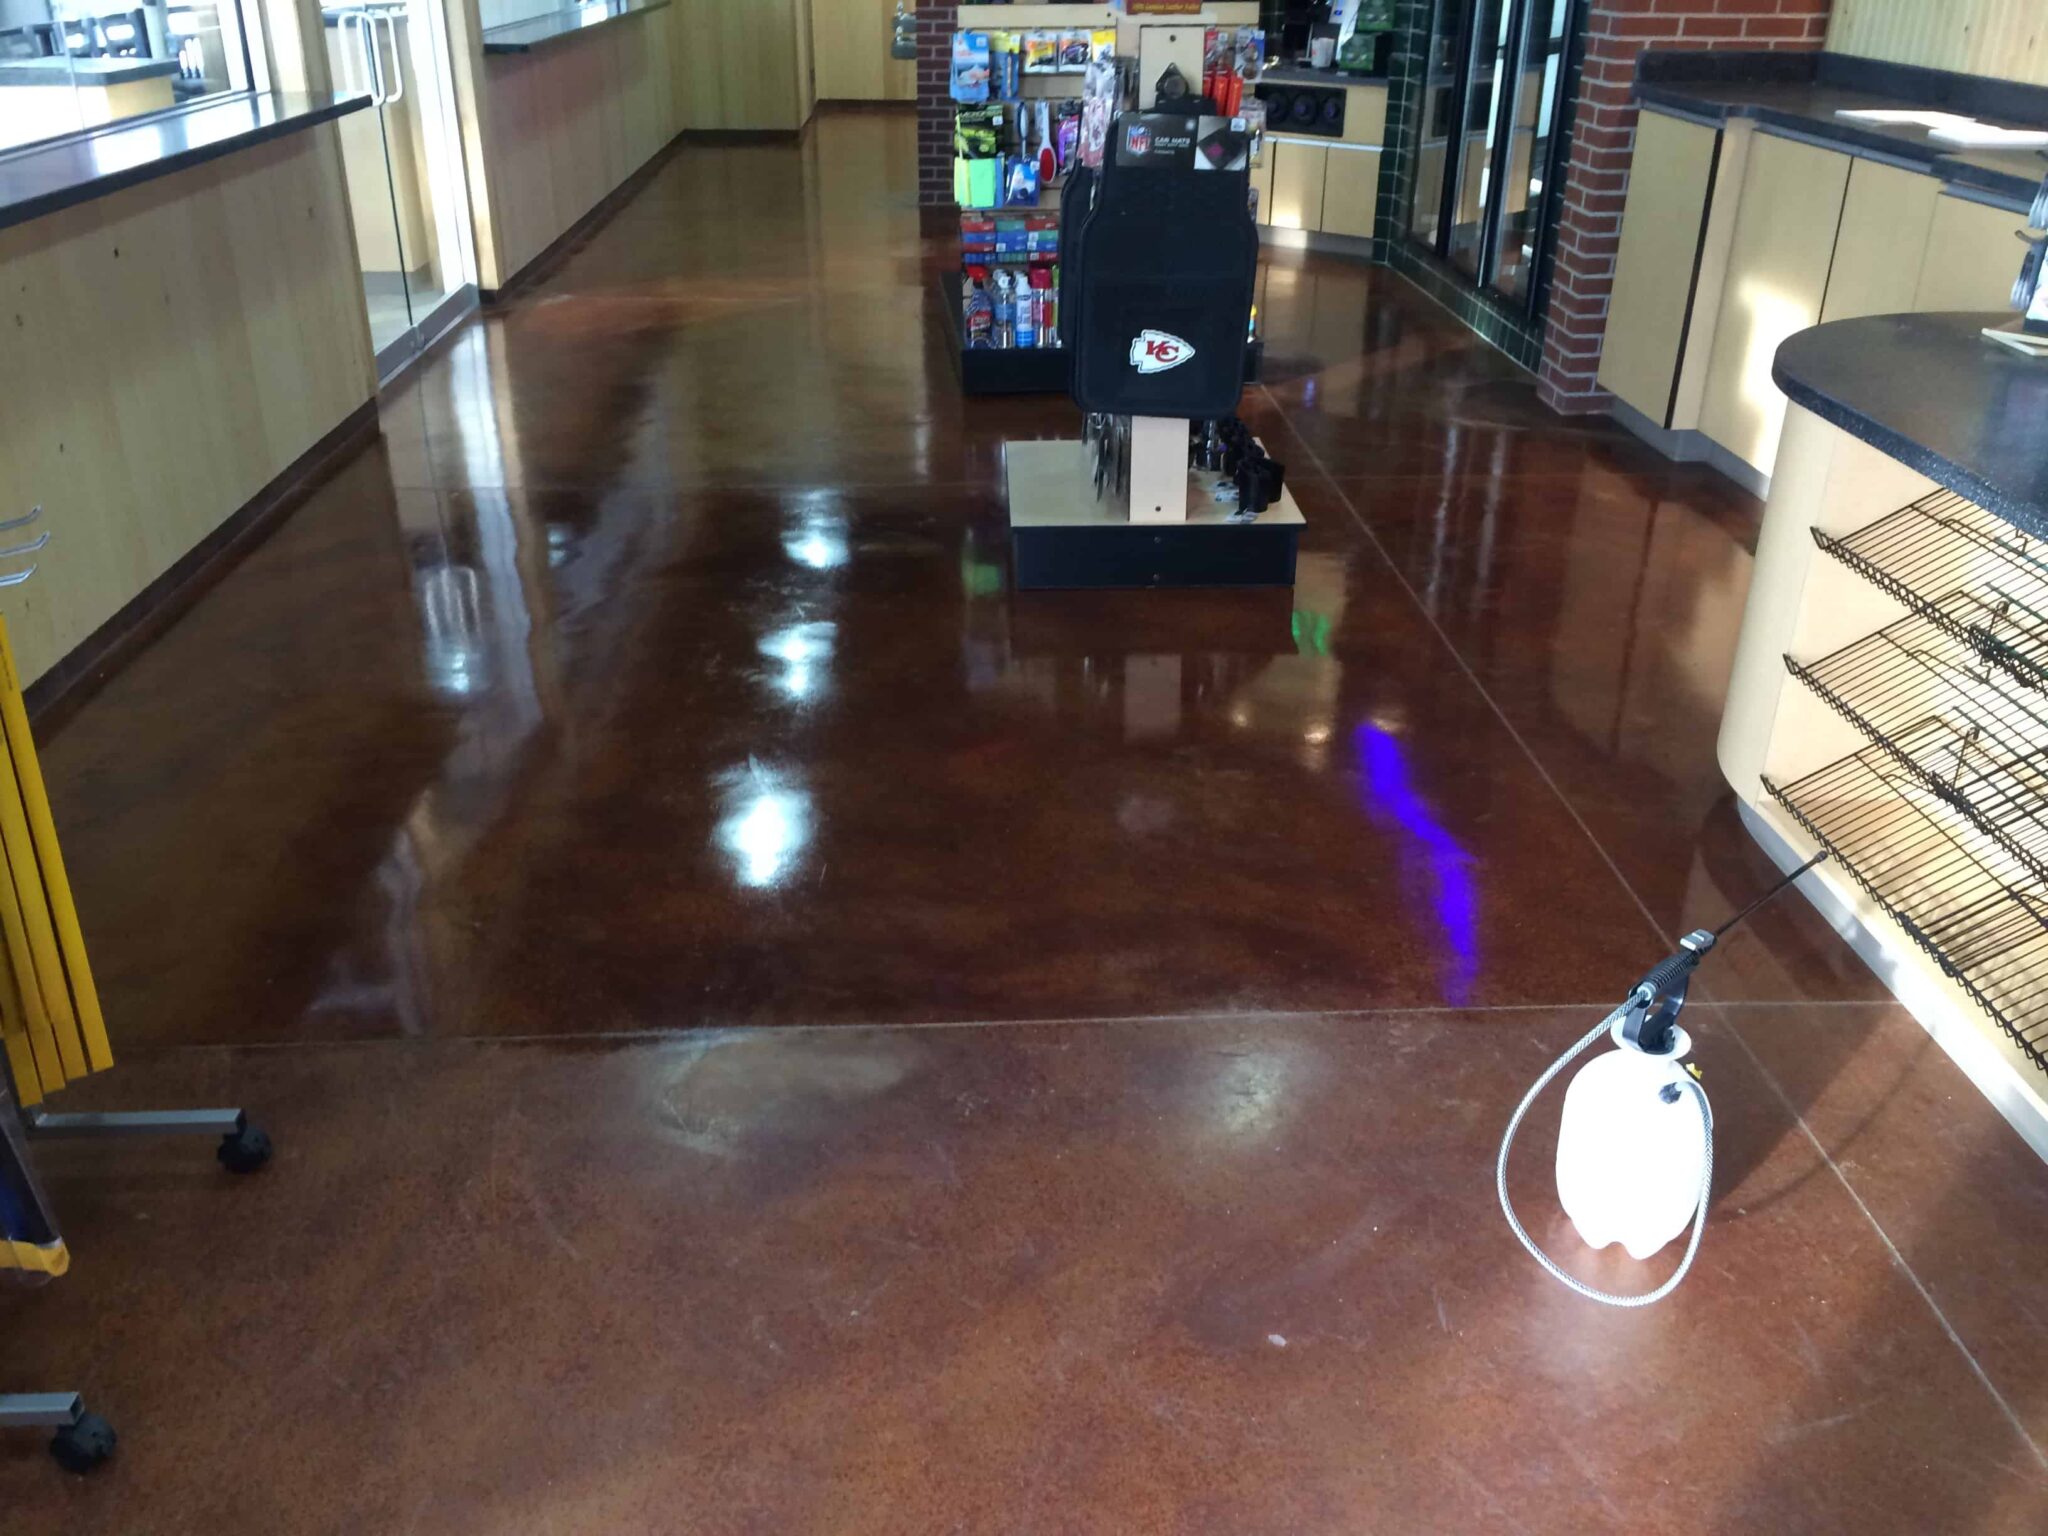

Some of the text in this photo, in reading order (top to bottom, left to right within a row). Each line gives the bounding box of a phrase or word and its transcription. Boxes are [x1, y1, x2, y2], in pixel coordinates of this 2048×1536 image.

[1154, 137, 1190, 145] CAR MATS
[1146, 340, 1179, 362] KC
